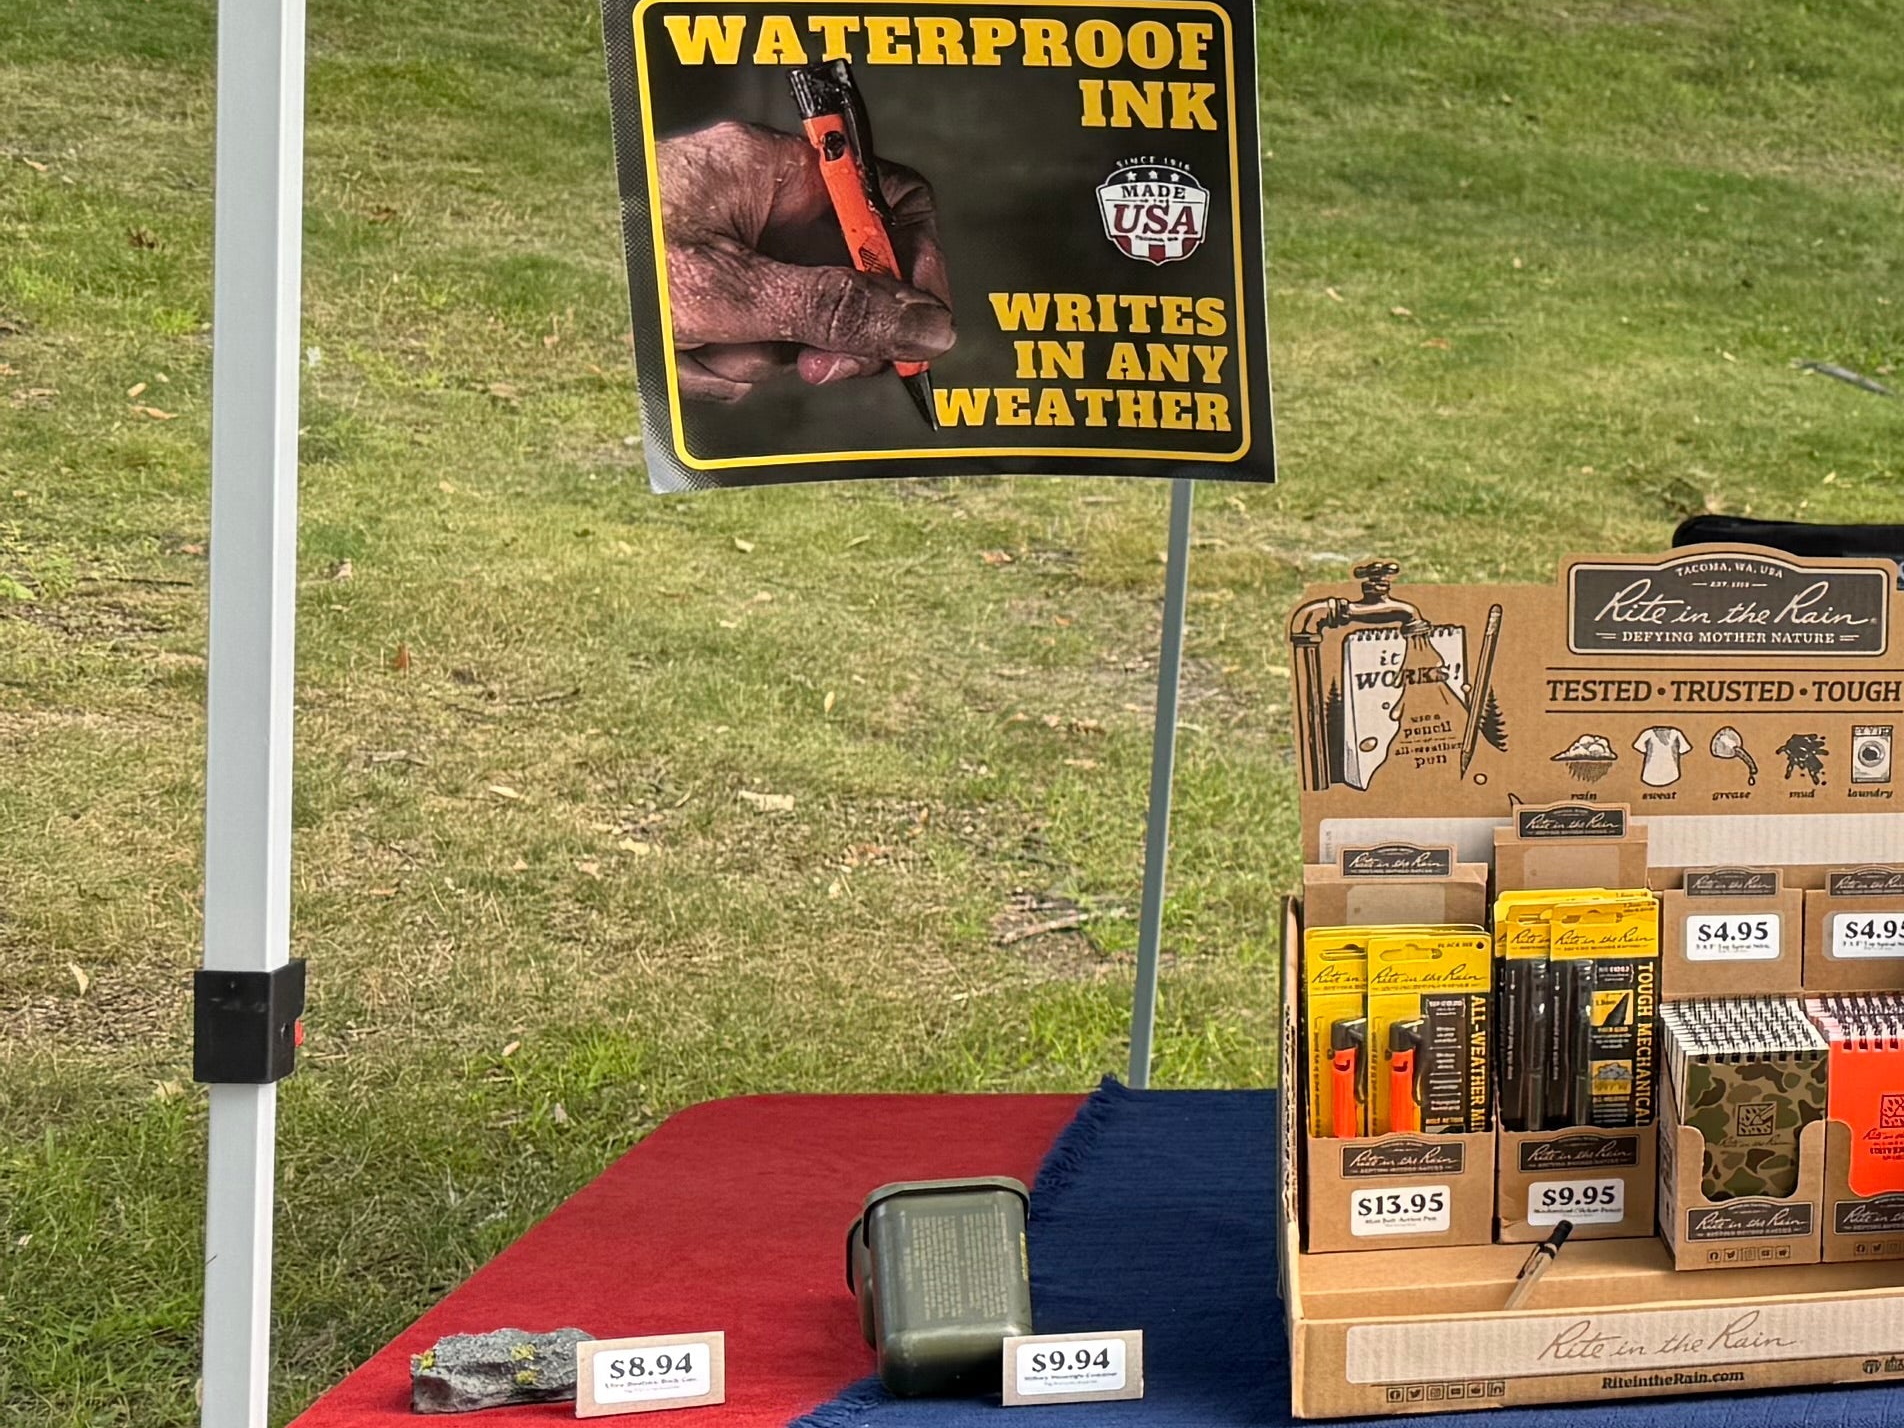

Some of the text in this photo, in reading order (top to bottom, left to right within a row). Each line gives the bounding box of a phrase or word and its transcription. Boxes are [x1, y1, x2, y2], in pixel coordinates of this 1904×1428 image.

[663, 13, 1214, 71] WATERPROOF
[1079, 79, 1218, 131] INK
[1116, 156, 1155, 168] SINCE
[1121, 184, 1186, 199] MADE
[1113, 203, 1198, 235] USA
[988, 292, 1228, 337] WRITES
[1013, 340, 1230, 385] IN ANY
[933, 387, 1232, 433] WEATHER
[1594, 578, 1684, 623] Rite
[1671, 605, 1712, 624] in
[1717, 602, 1771, 625] the
[1622, 630, 1835, 645] DEFYING MOTHER NATURE
[1379, 650, 1401, 666] it
[1355, 663, 1461, 691] WORKS!
[1547, 679, 1652, 703] TESTED
[1670, 679, 1795, 703] TRUSTED
[1403, 721, 1452, 738] pencil
[1641, 790, 1677, 801] sweat
[1711, 790, 1752, 802] grease
[1788, 788, 1816, 799] mud
[1847, 787, 1893, 800] laundry
[1698, 921, 1768, 942] $4.95
[1470, 995, 1488, 1106] ALL-WEATHER
[1634, 961, 1655, 1127] TOUGH MECHANICAL
[1358, 1192, 1444, 1217] $13.95
[1542, 1185, 1616, 1208] $9.95
[1537, 1309, 1797, 1361] Rite in the Rain
[610, 1352, 692, 1379] $8.94
[1031, 1347, 1110, 1373] $9.94
[1601, 1369, 1745, 1391] RiteintheRain.com
